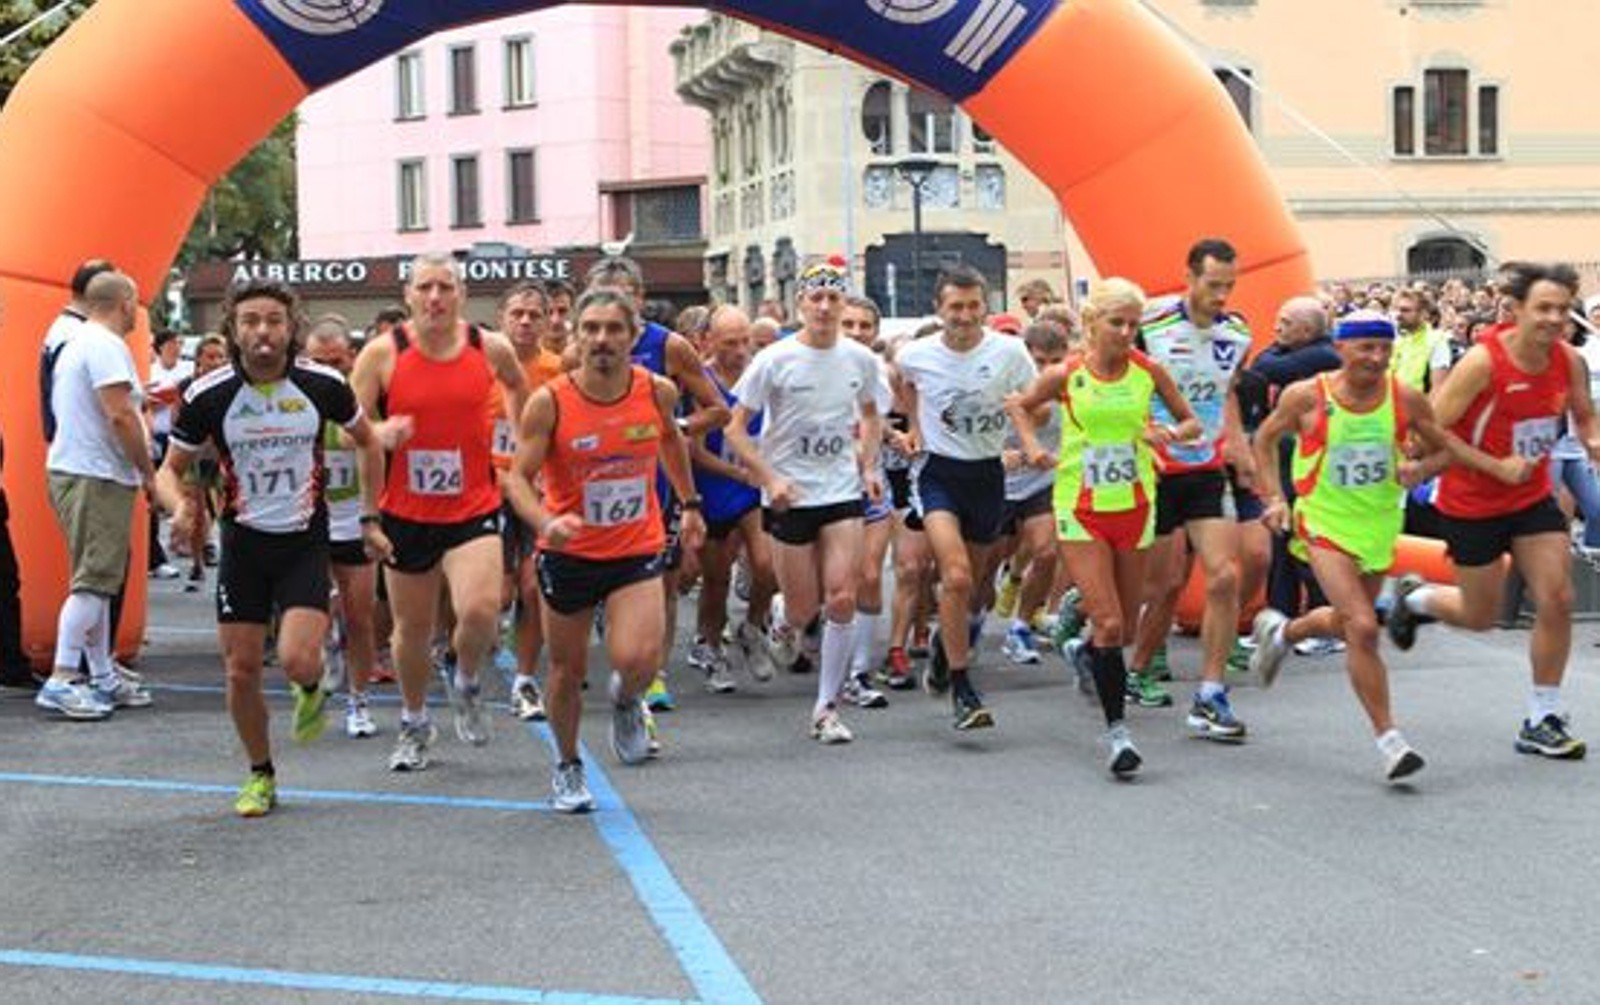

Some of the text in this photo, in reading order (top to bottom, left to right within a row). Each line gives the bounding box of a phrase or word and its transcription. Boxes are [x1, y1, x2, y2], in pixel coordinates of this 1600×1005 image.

[963, 410, 1005, 434] 120
[801, 436, 844, 457] 160
[248, 467, 297, 494] 171
[1088, 459, 1137, 485] 163
[1336, 461, 1387, 486] 135
[590, 497, 643, 522] 167
